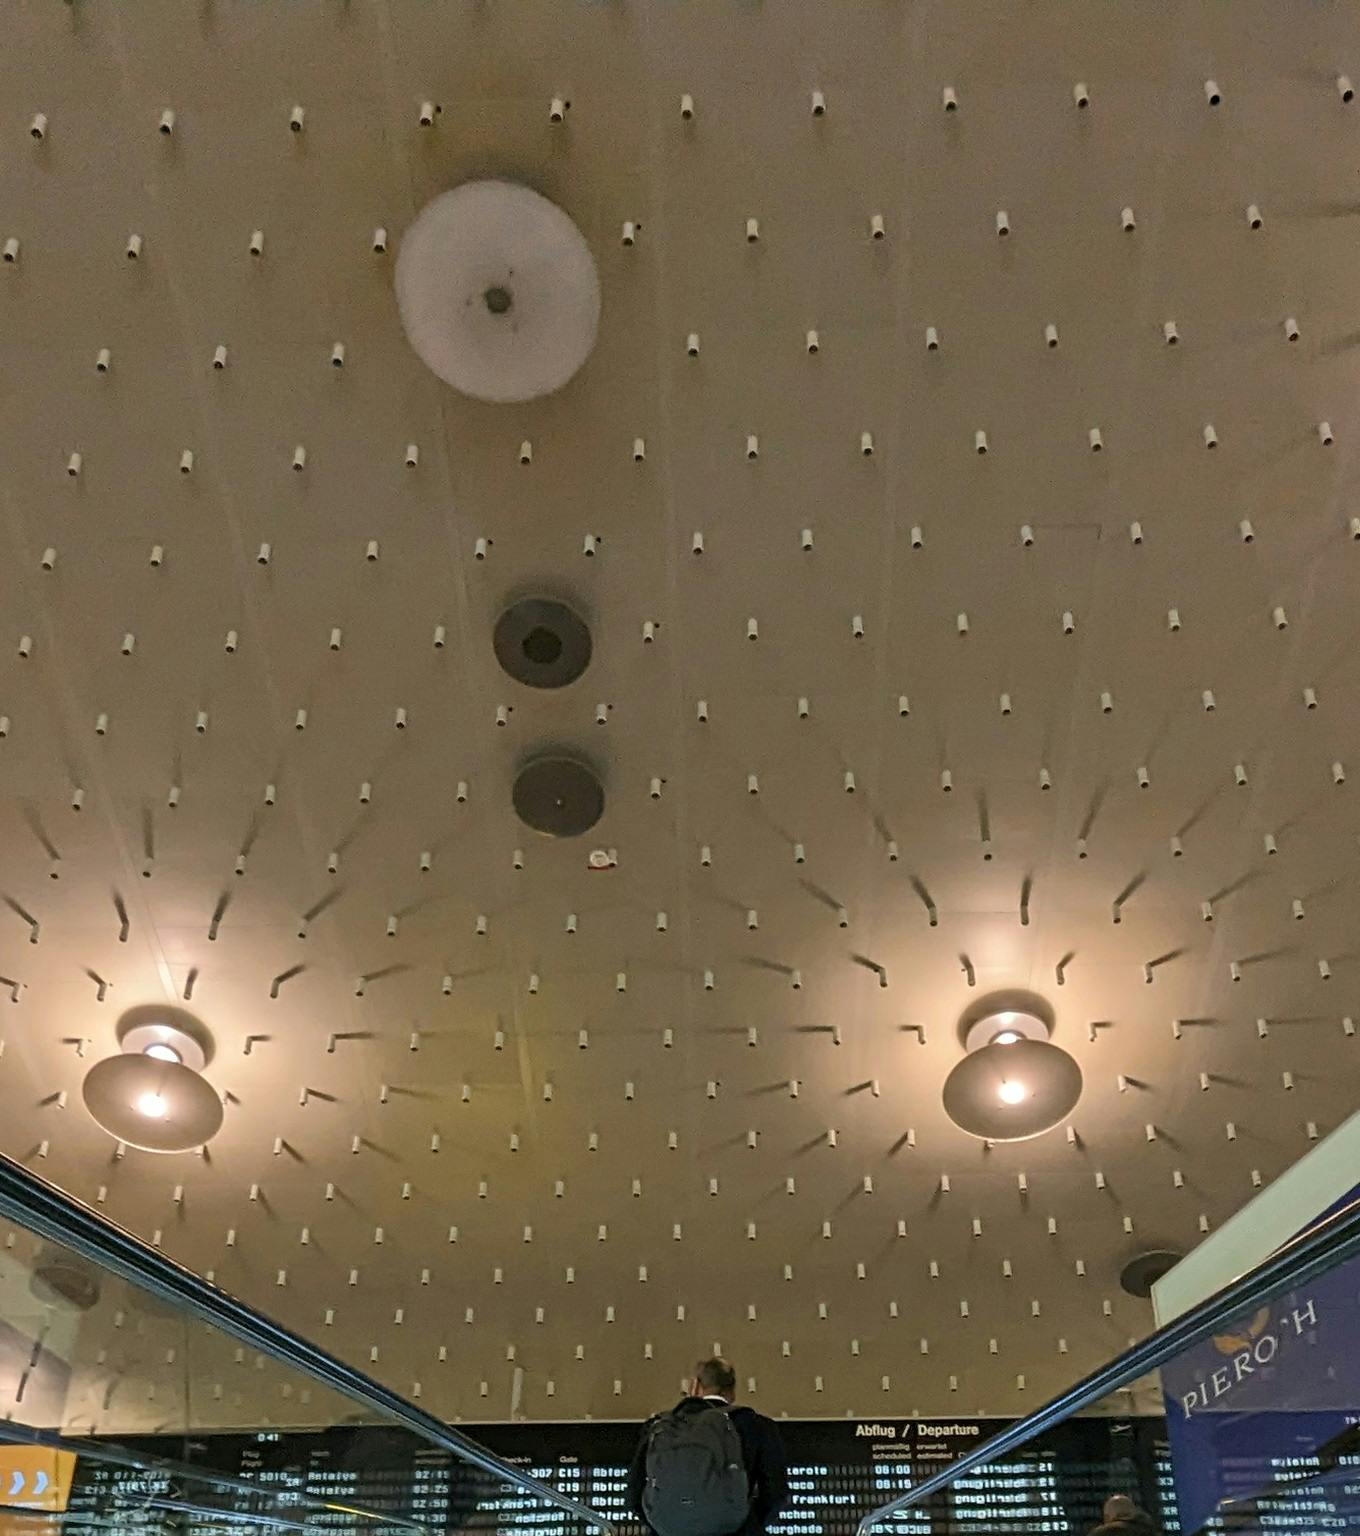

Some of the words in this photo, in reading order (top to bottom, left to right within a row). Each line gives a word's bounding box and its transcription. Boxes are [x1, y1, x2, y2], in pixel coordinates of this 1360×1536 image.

[1181, 1298, 1318, 1419] PIEROH
[856, 1424, 896, 1437] Abflug
[918, 1424, 980, 1438] Departure
[792, 1494, 856, 1505] Frankfurt
[778, 1509, 816, 1519] nchen
